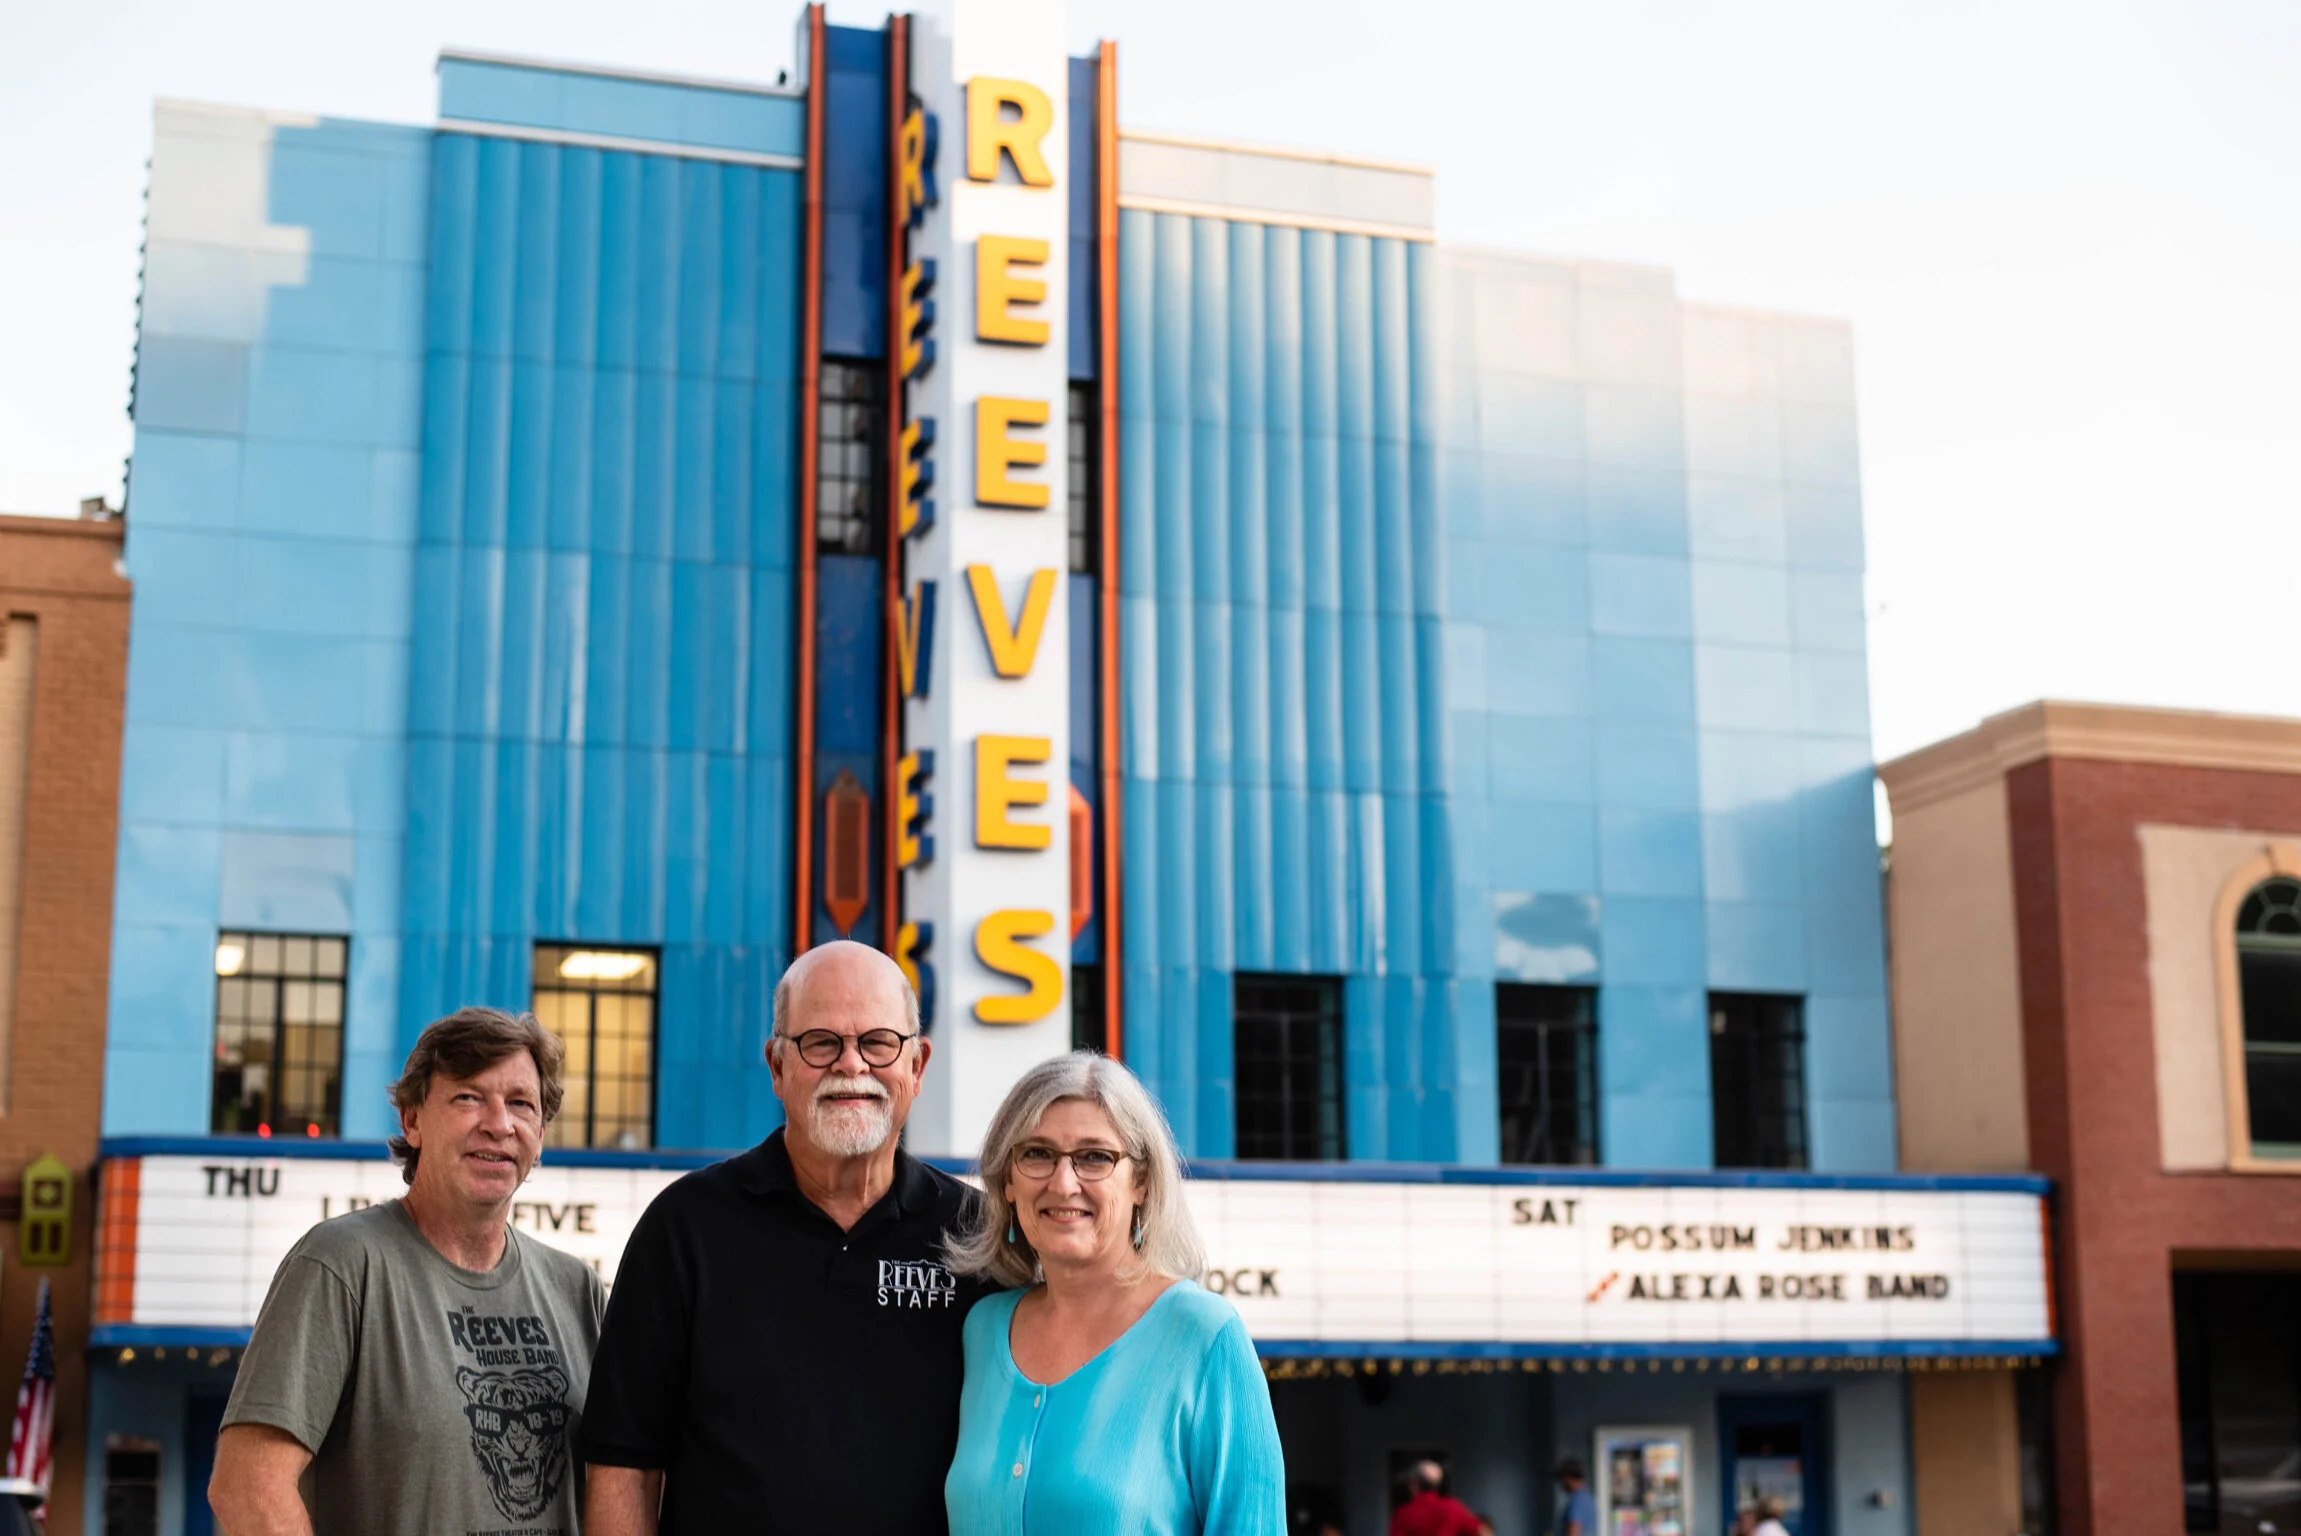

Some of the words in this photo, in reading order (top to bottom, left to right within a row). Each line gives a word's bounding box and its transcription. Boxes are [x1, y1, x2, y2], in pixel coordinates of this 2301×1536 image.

[966, 75, 1065, 1024] REEVES
[202, 1165, 279, 1197] THU
[1513, 1198, 1580, 1226] SAT
[1611, 1224, 1756, 1251] POSSUM
[1777, 1225, 1916, 1251] JENKINS
[878, 1260, 956, 1293] REEVES
[1627, 1273, 1744, 1302] ALEXA
[1758, 1273, 1847, 1302] ROSE
[1866, 1273, 1950, 1301] BAND
[461, 1305, 475, 1314] THE
[877, 1287, 956, 1309] STAFF
[447, 1311, 550, 1353] REEVES
[476, 1348, 521, 1367] HOUSE
[522, 1347, 560, 1366] BAND
[475, 1408, 501, 1432] RHB
